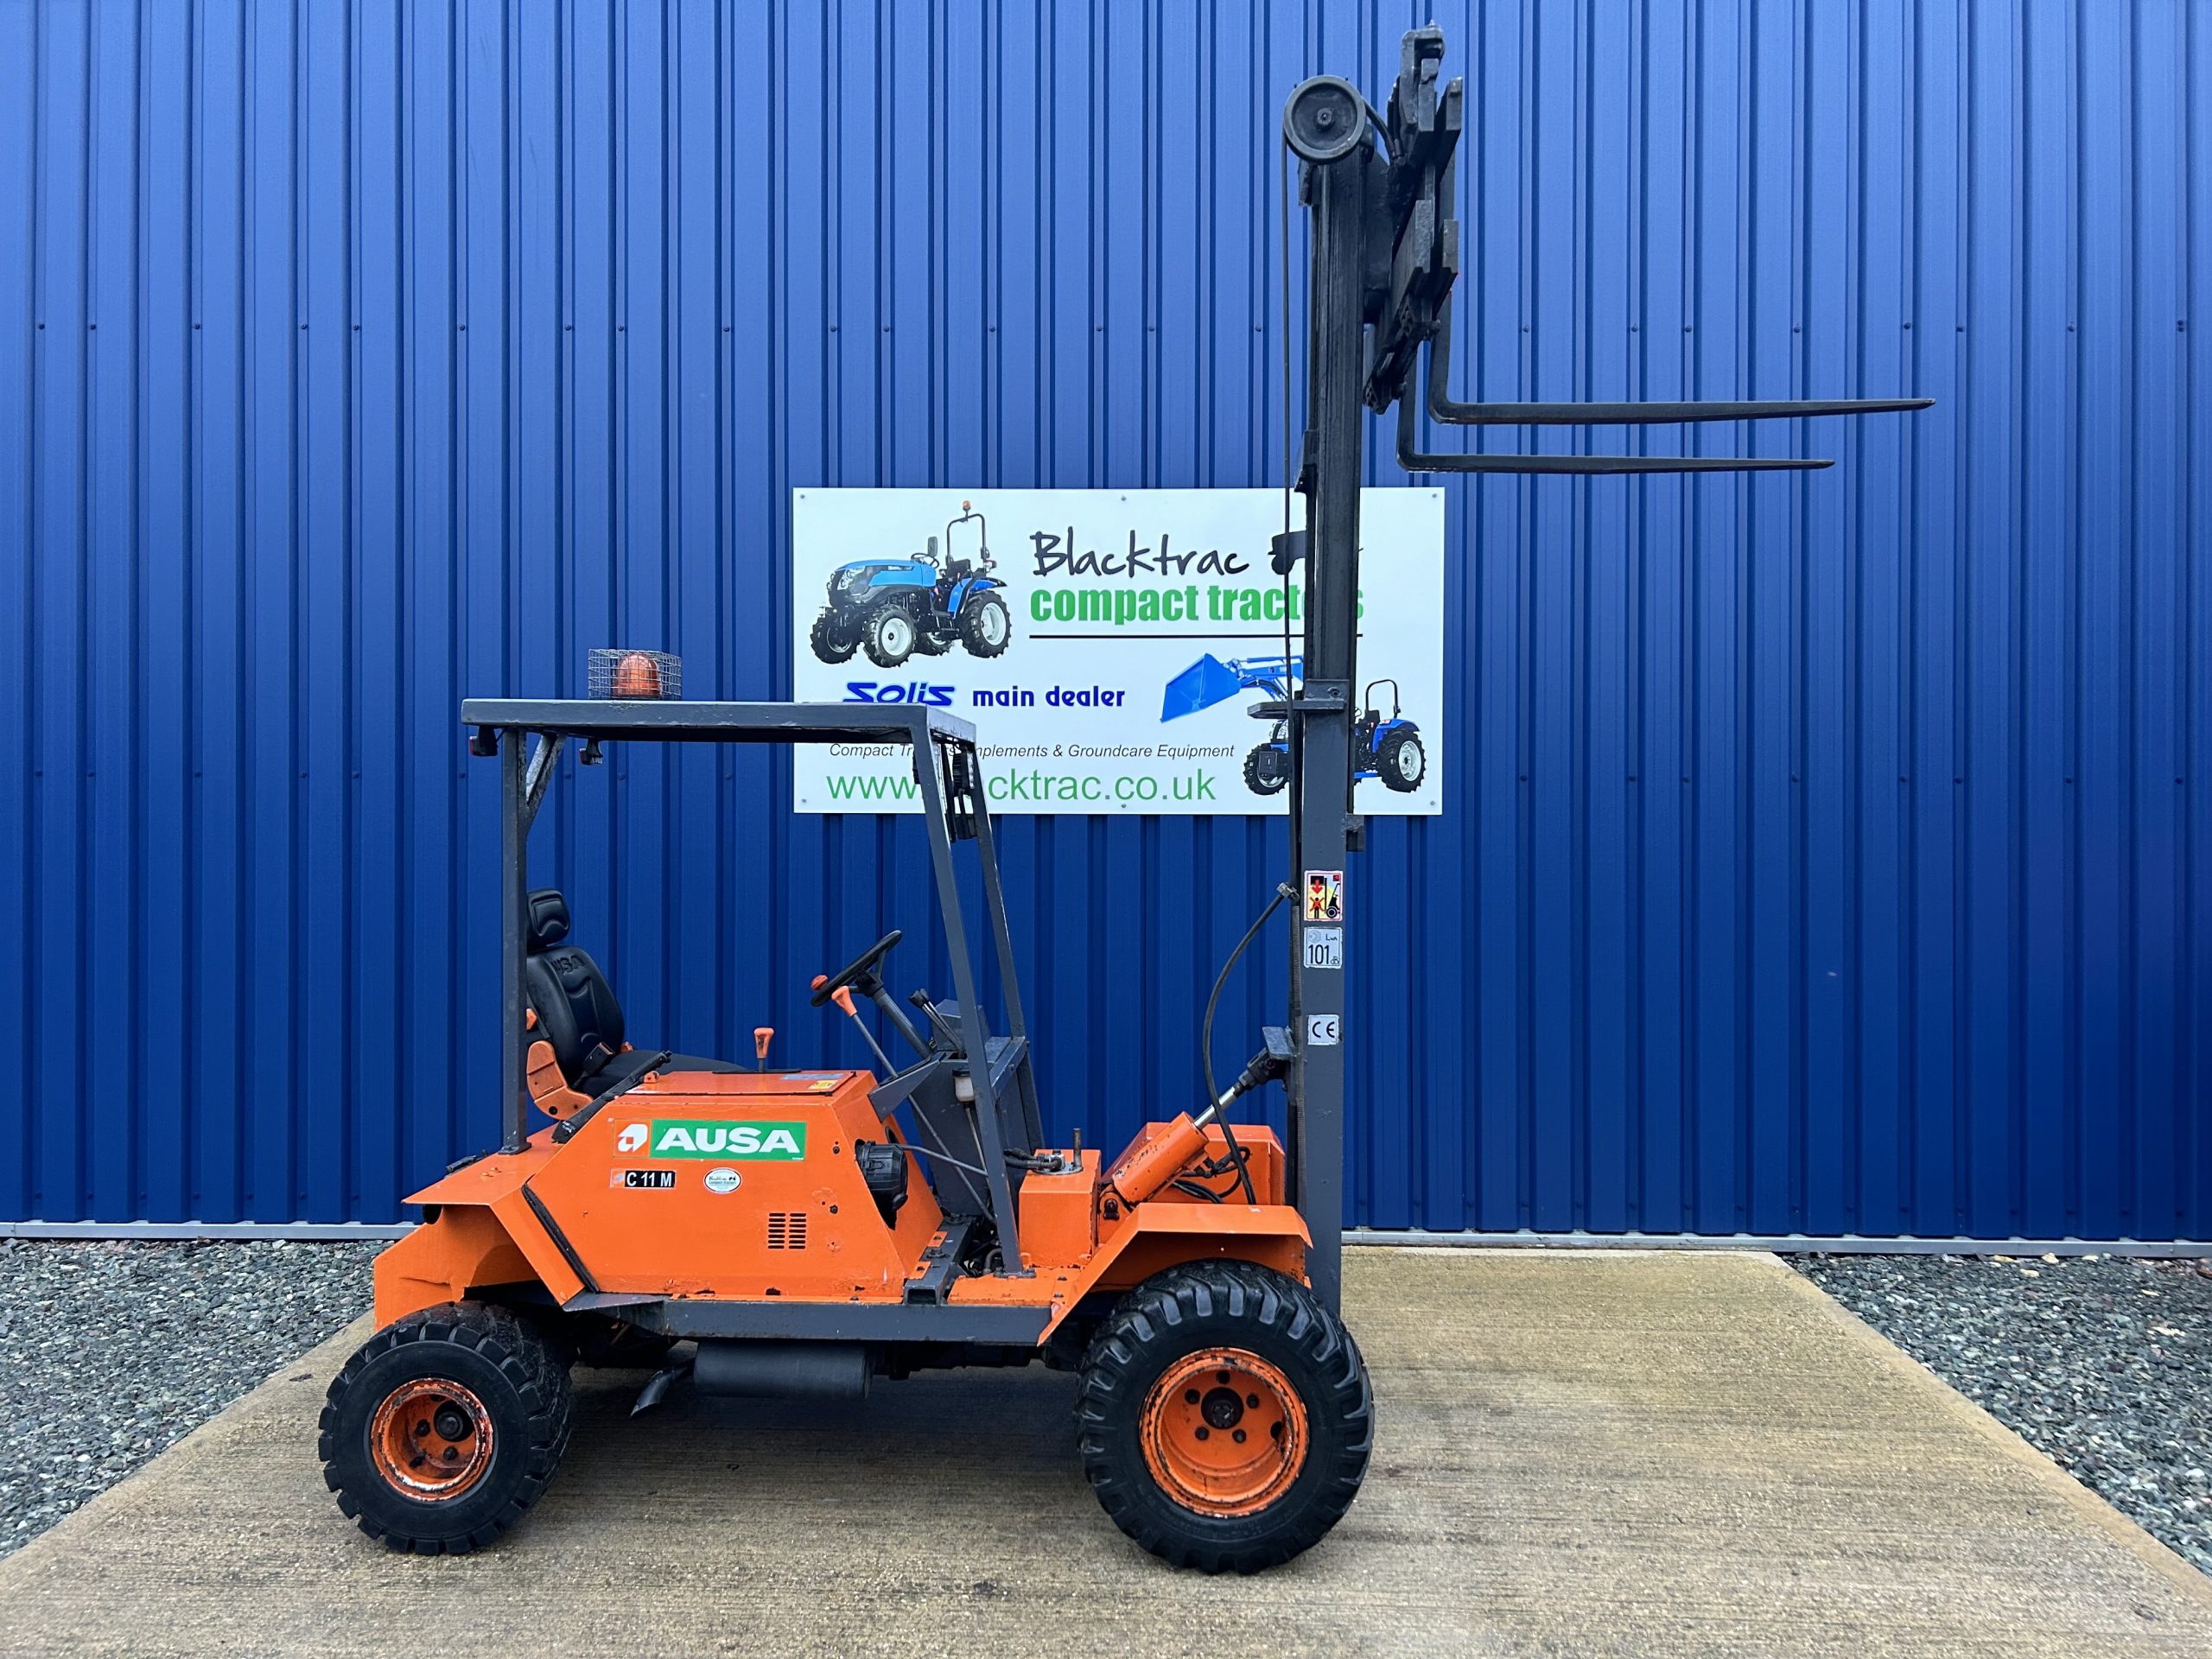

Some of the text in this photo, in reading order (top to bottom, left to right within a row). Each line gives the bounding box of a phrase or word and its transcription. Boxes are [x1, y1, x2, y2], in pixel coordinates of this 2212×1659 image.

[1029, 526, 1249, 578] Blacktrac
[1030, 584, 1363, 626] compact tract
[973, 685, 1034, 707] main
[1045, 685, 1125, 707] dealer
[830, 743, 894, 759] Compact
[974, 744, 1048, 760] mplements
[1052, 744, 1064, 757] &
[1068, 744, 1153, 757] Groundcare
[1157, 743, 1235, 760] Equipment
[1308, 944, 1329, 964] 101
[1312, 1020, 1335, 1038] CE
[655, 1127, 800, 1154] AUSA
[626, 1172, 672, 1187] C 11 M
